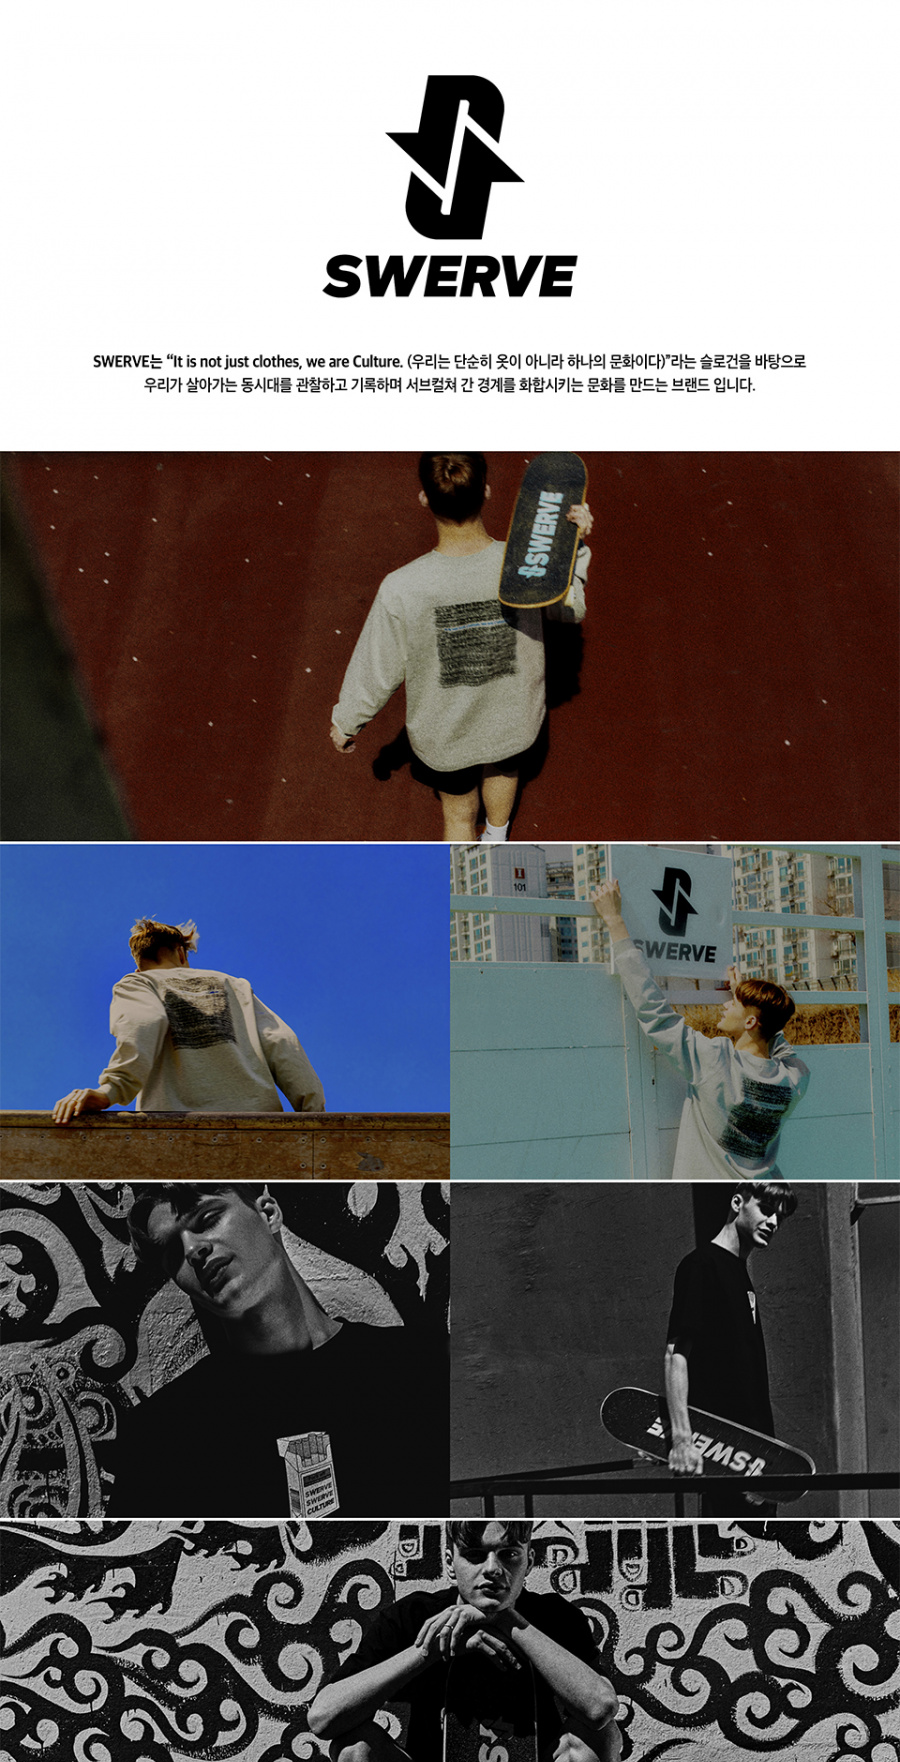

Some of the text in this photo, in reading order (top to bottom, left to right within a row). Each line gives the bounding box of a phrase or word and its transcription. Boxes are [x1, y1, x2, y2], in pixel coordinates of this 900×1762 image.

[525, 491, 564, 566] SWERVE
[513, 883, 527, 892] 101
[305, 1482, 332, 1498] SWERVE
[306, 1490, 333, 1507] SWERVE
[307, 1498, 335, 1515] CULTURE
